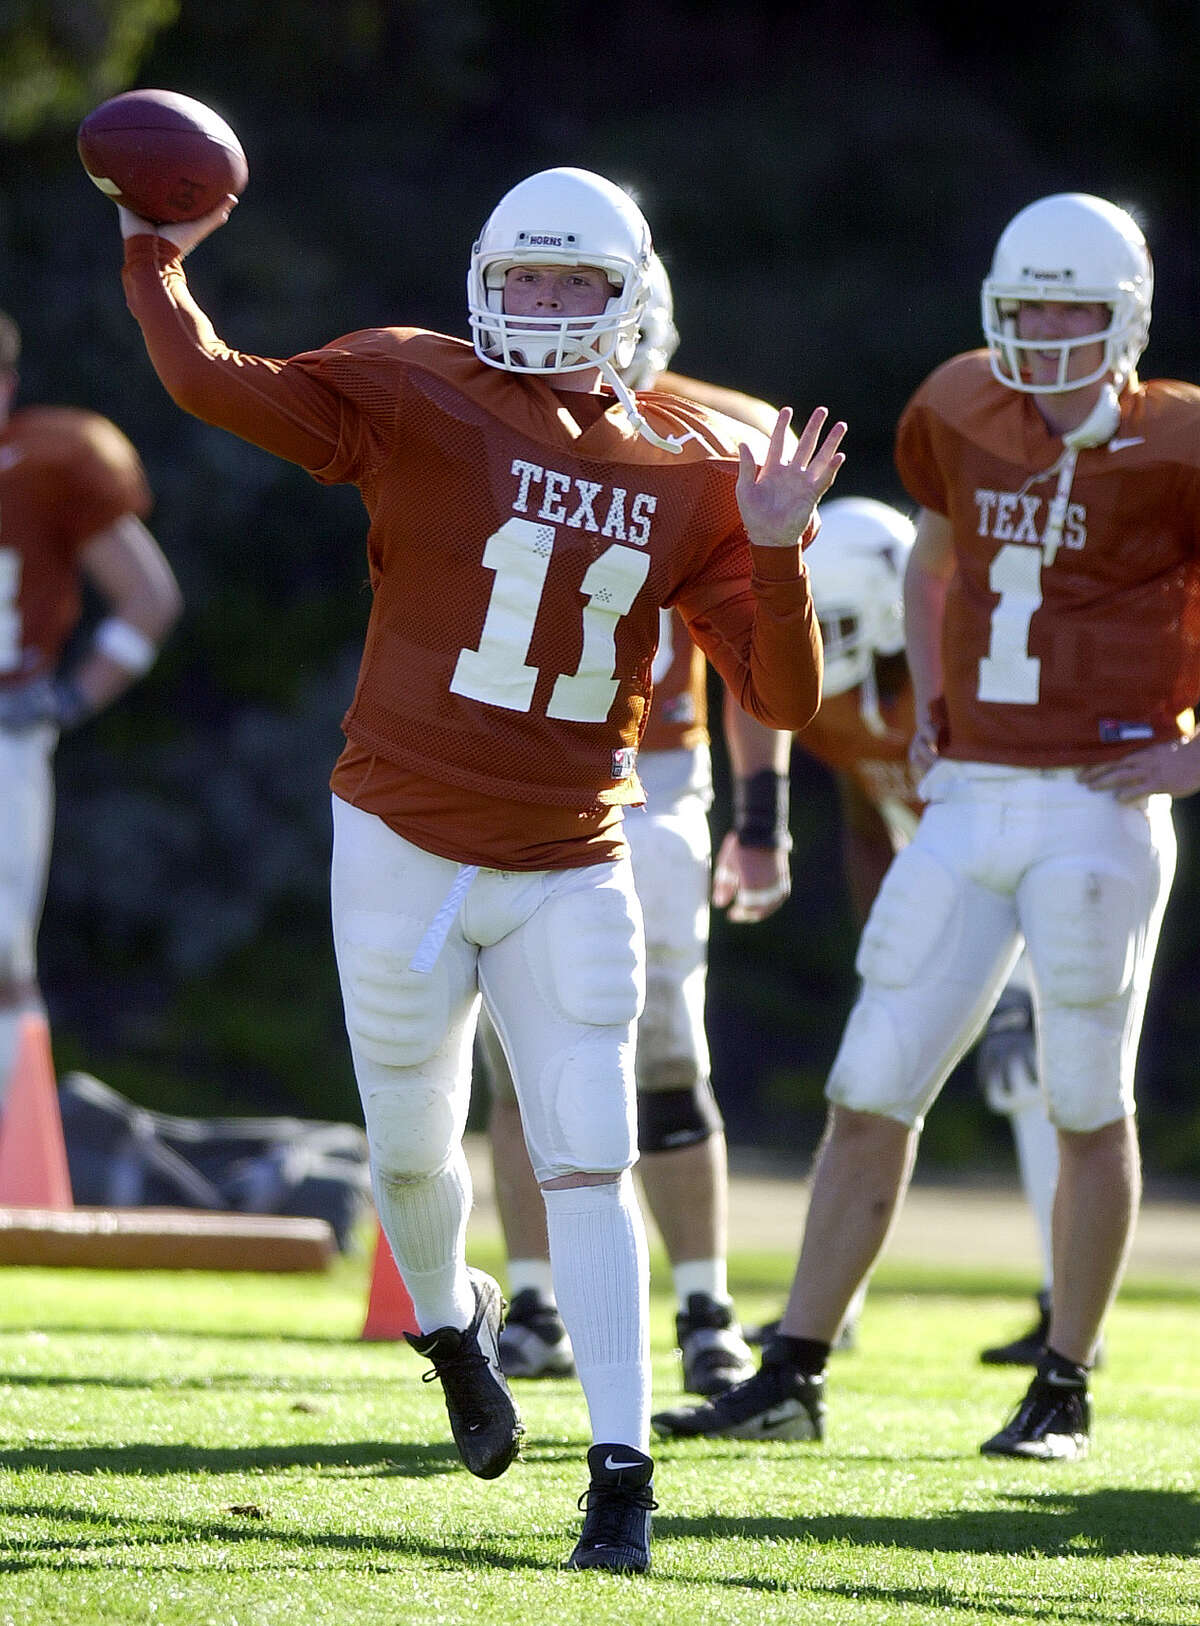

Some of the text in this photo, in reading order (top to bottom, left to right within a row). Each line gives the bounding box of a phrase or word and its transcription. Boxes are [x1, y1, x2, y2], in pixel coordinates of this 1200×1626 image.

[530, 235, 562, 247] HORNS
[511, 459, 657, 546] TEXAS
[450, 517, 651, 723] 11
[977, 543, 1043, 704] 1
